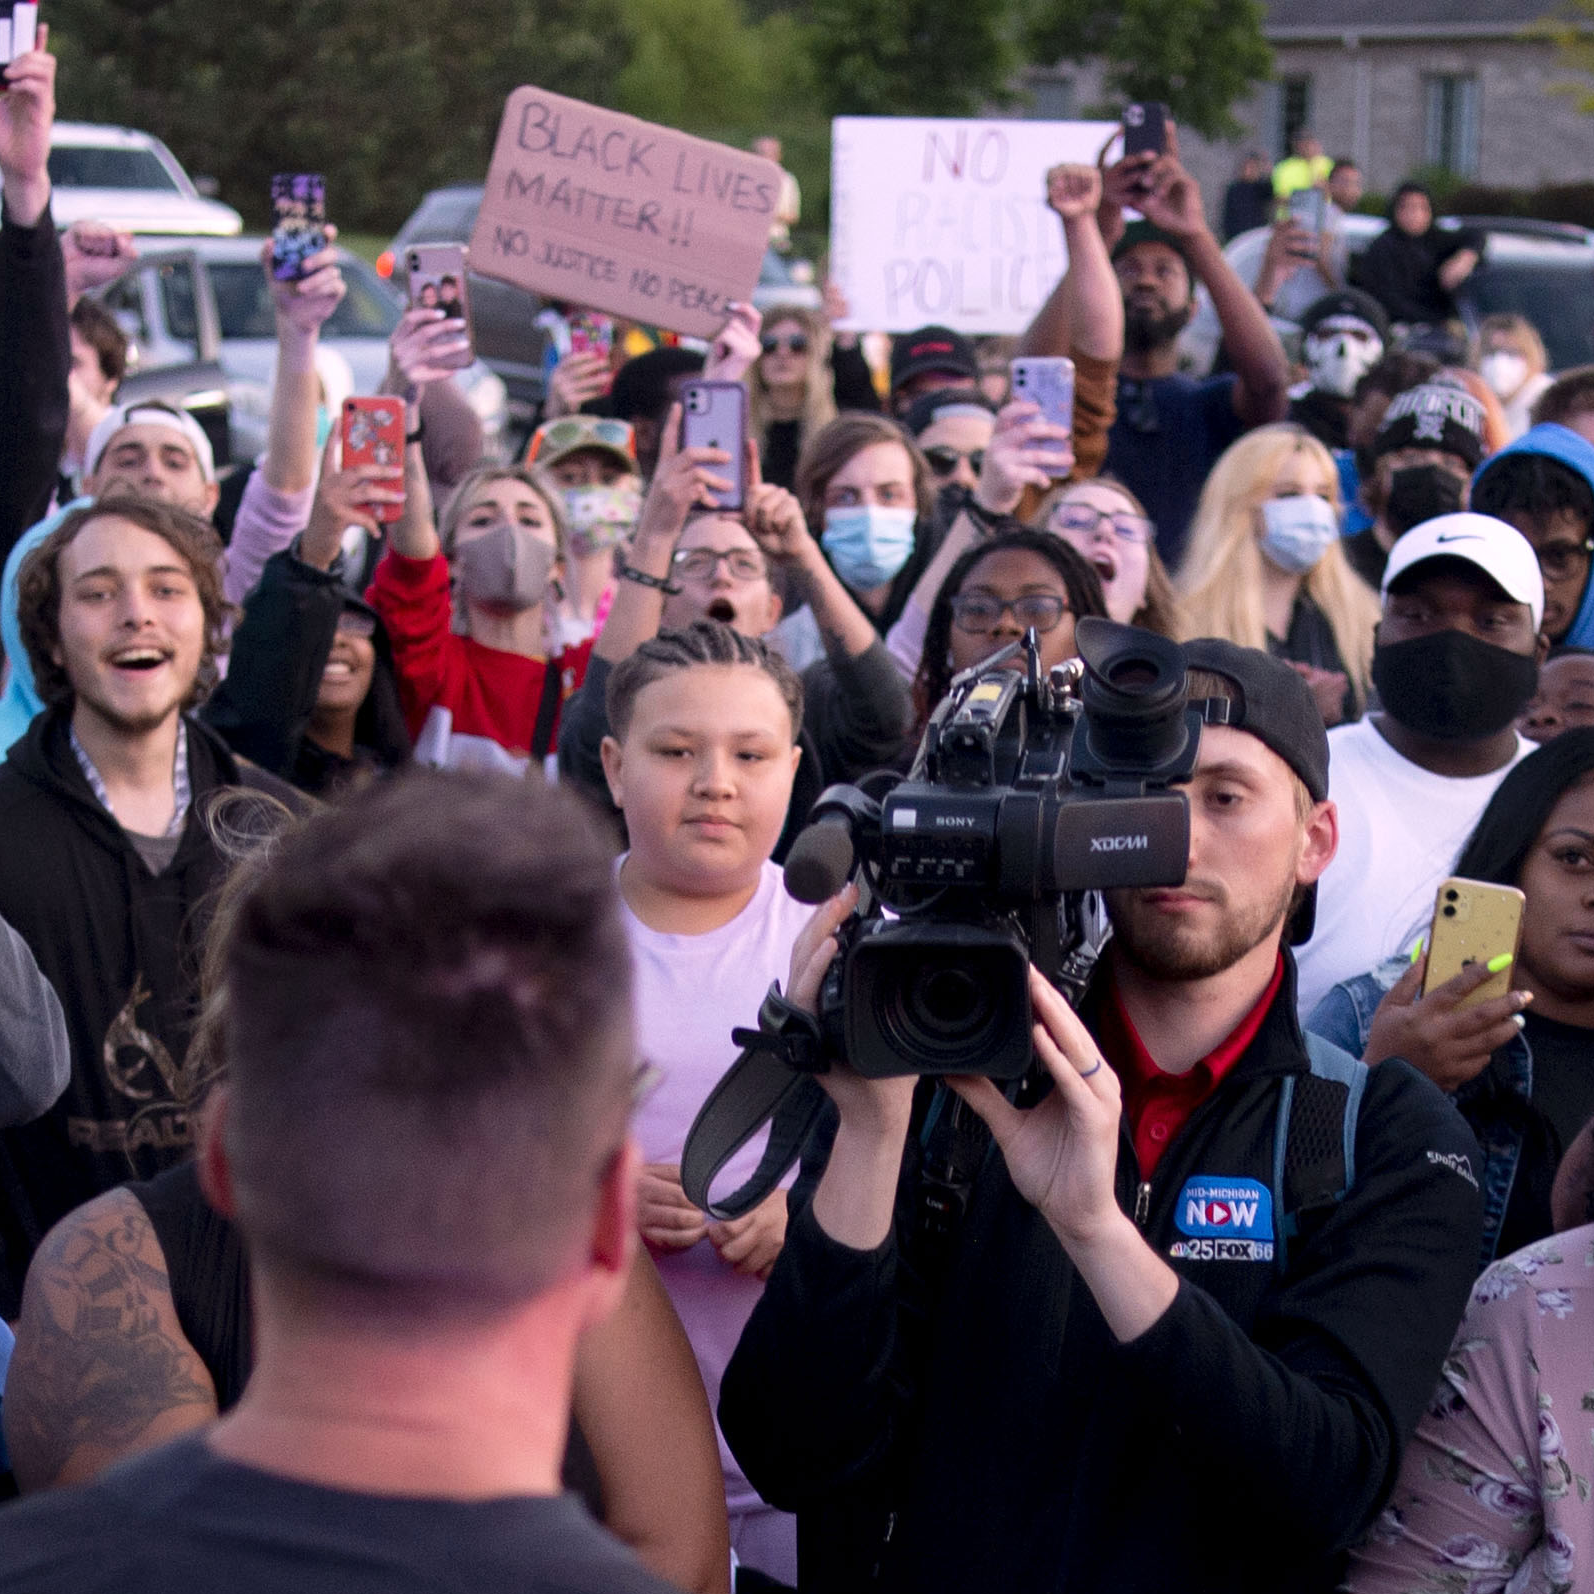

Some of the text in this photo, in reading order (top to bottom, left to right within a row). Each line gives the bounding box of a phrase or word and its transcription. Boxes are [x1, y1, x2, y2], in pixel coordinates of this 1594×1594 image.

[518, 101, 774, 213] BLACK LIVES
[922, 127, 1009, 187] NO
[493, 224, 530, 257] NO
[629, 268, 662, 297] NO
[935, 816, 976, 828] SONY
[1089, 835, 1149, 852] XDCAM
[1186, 1187, 1259, 1199] MID-MICHIGAN
[1185, 1199, 1259, 1228] NOW
[1189, 1238, 1274, 1260] 25 FOX 66
